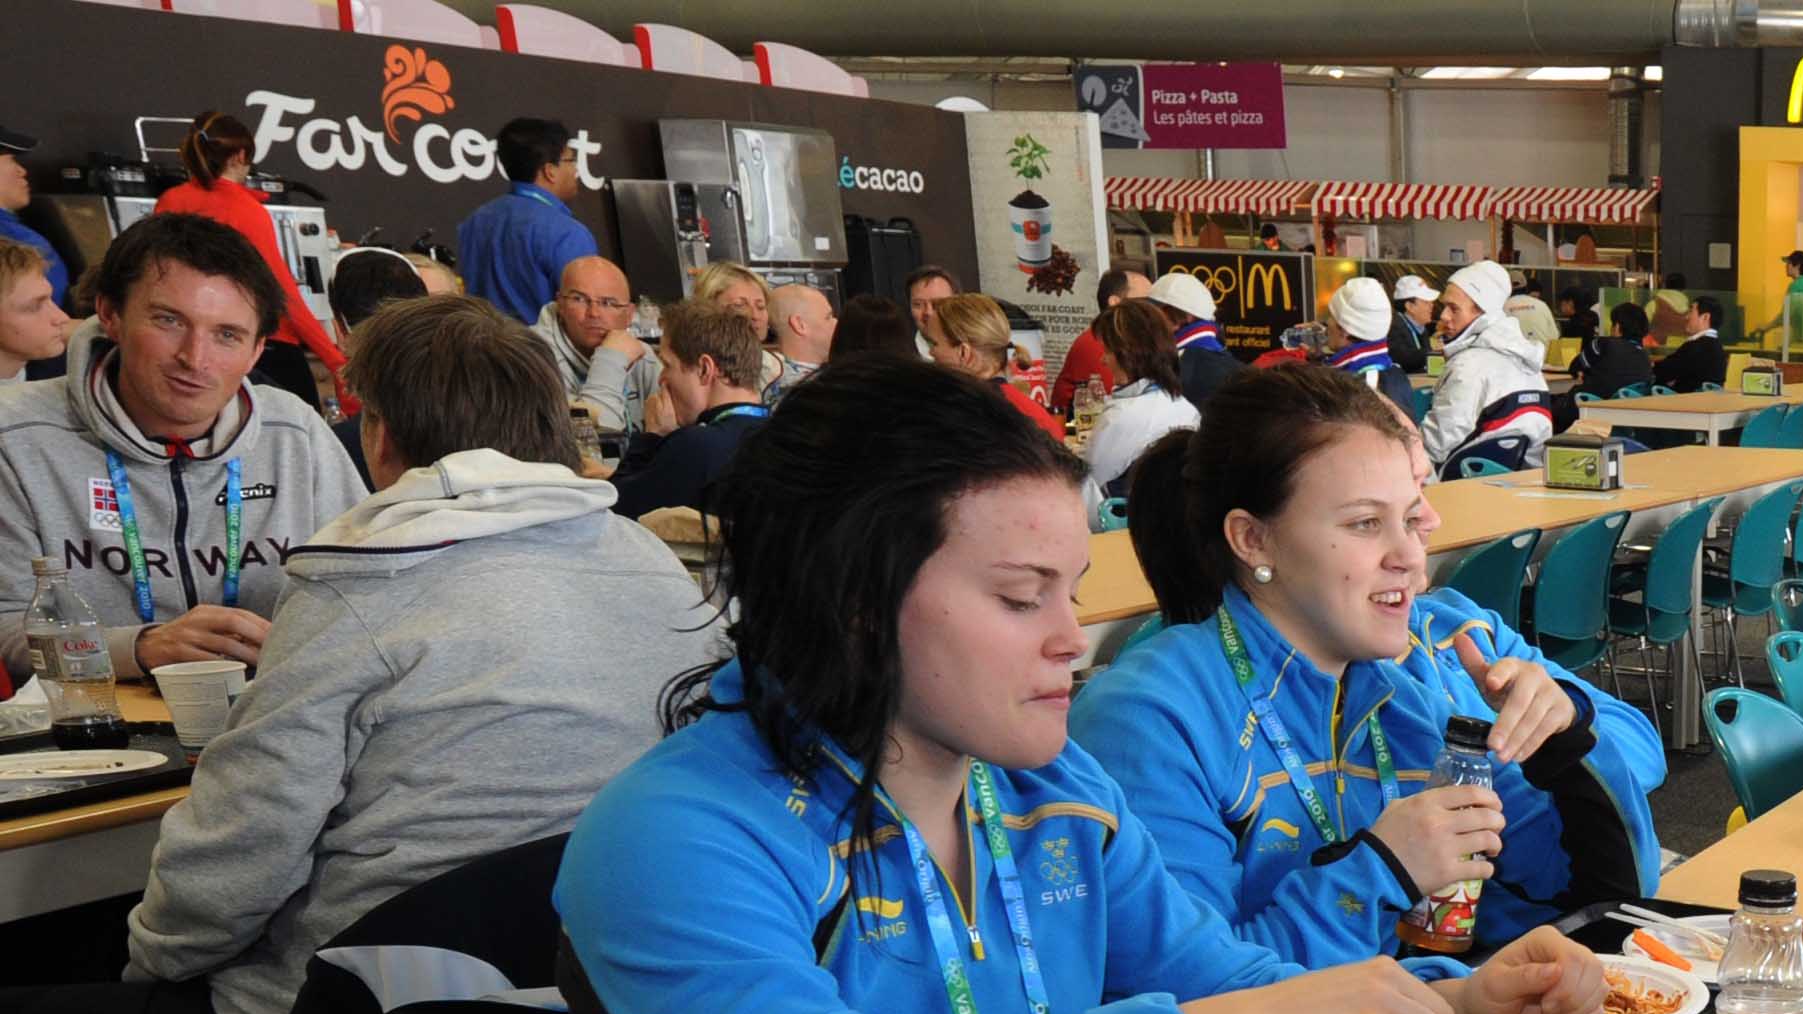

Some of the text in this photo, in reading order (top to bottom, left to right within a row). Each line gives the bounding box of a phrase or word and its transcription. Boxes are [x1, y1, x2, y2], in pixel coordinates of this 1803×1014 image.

[1151, 89, 1186, 105] Pizza
[1200, 89, 1239, 105] Pasta
[1153, 109, 1264, 127] Les pâtes et pizza
[245, 90, 605, 191] Far cot
[838, 156, 924, 194] écacao
[1040, 884, 1088, 906] SWE
